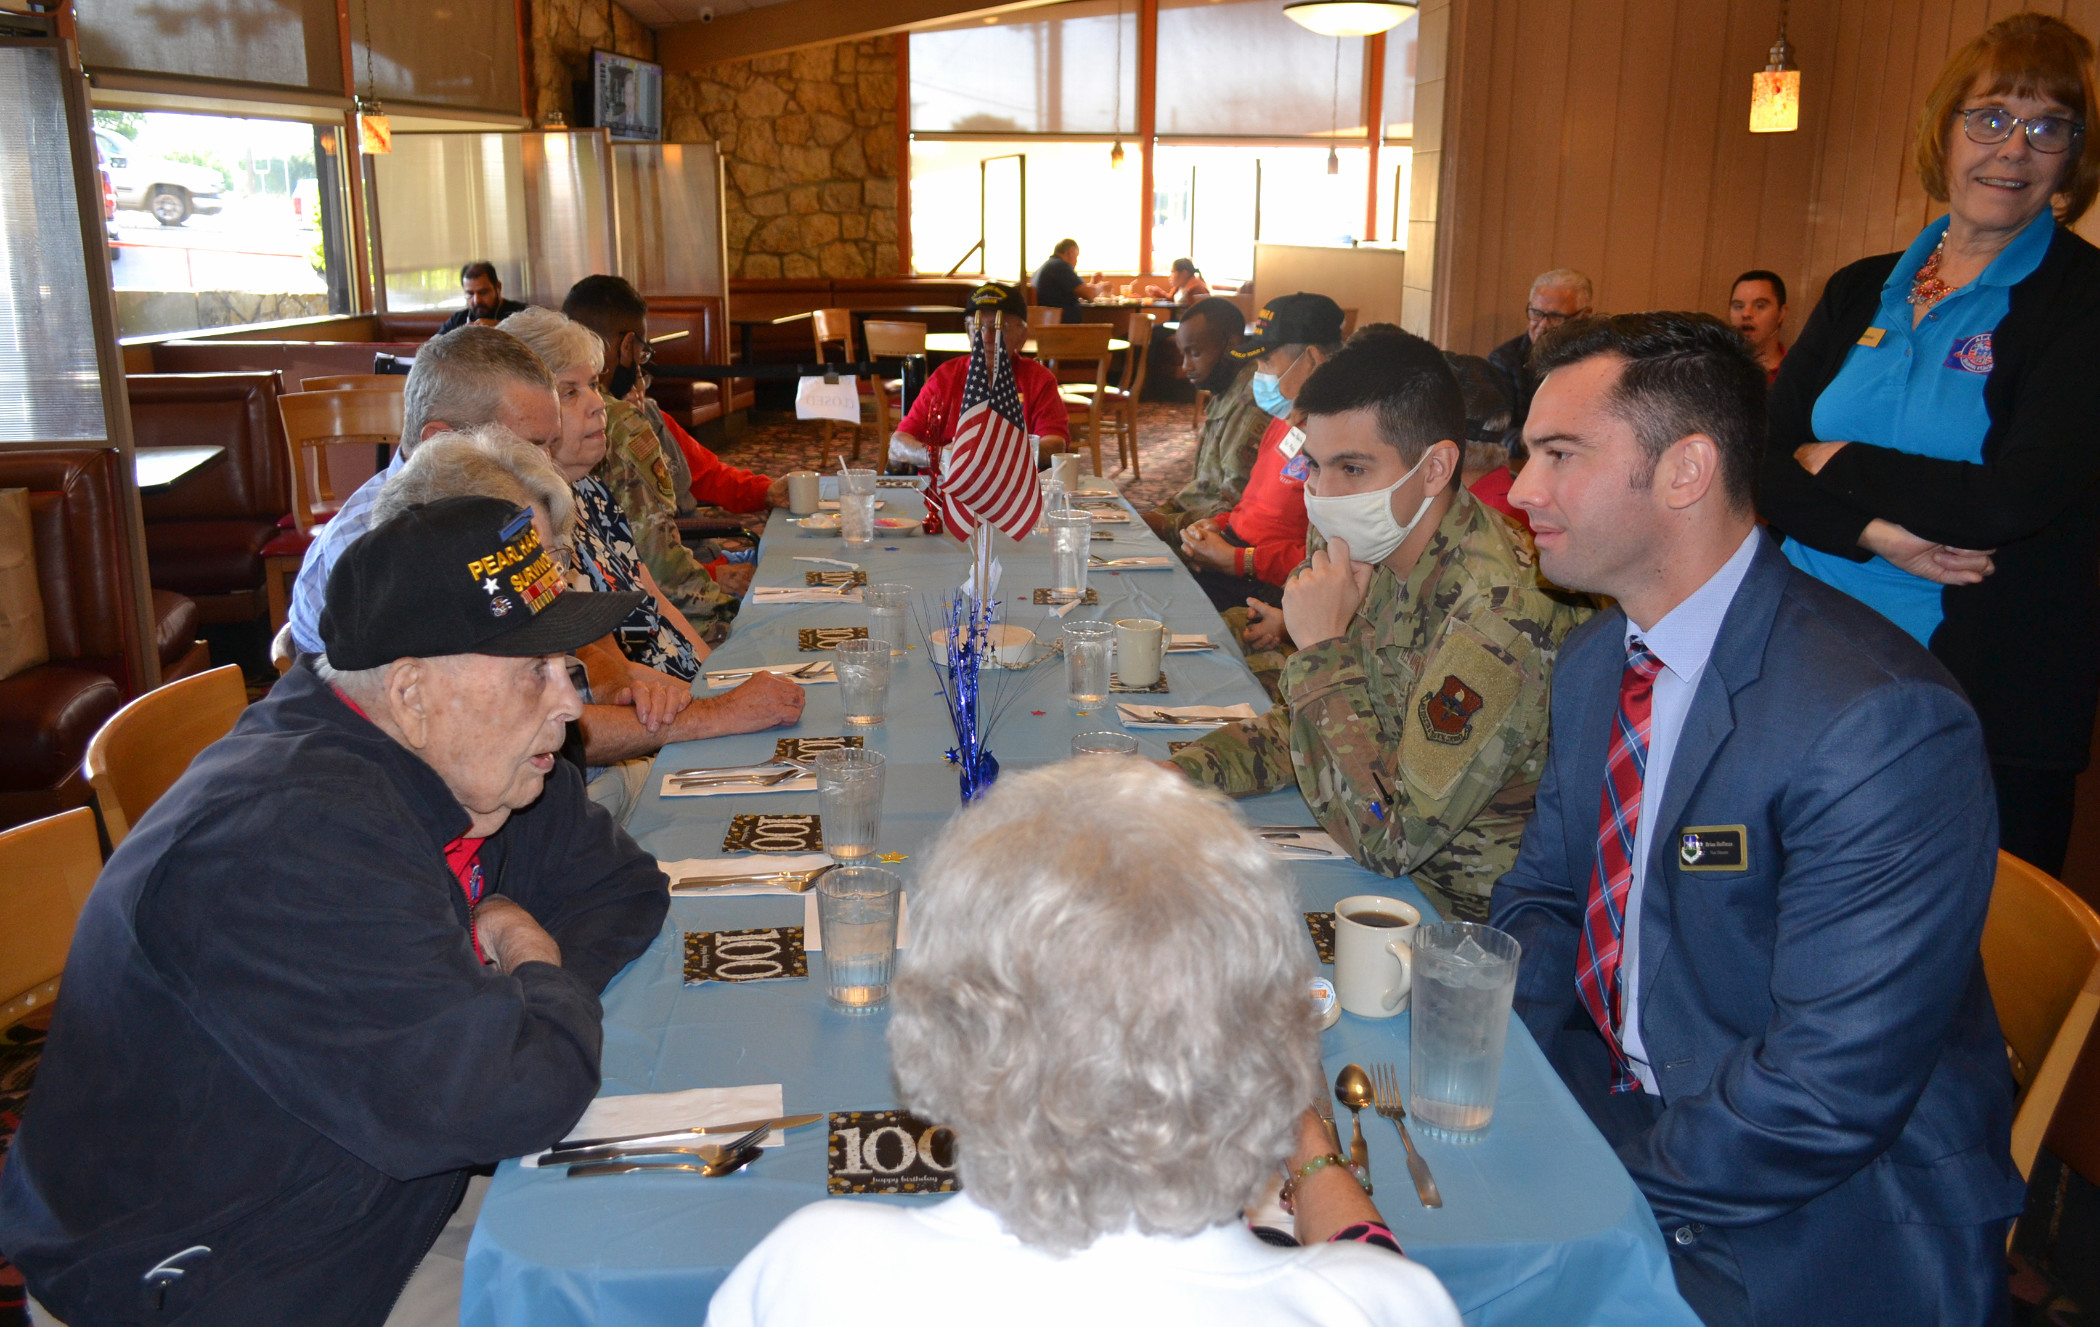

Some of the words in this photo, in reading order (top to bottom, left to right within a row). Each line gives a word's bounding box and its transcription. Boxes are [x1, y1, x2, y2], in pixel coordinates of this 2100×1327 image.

[467, 544, 524, 581] PEARL
[750, 815, 813, 850] 100
[715, 928, 783, 979] 100
[834, 1126, 959, 1174] 100
[872, 1176, 899, 1184] happy
[900, 1174, 938, 1183] birthday
